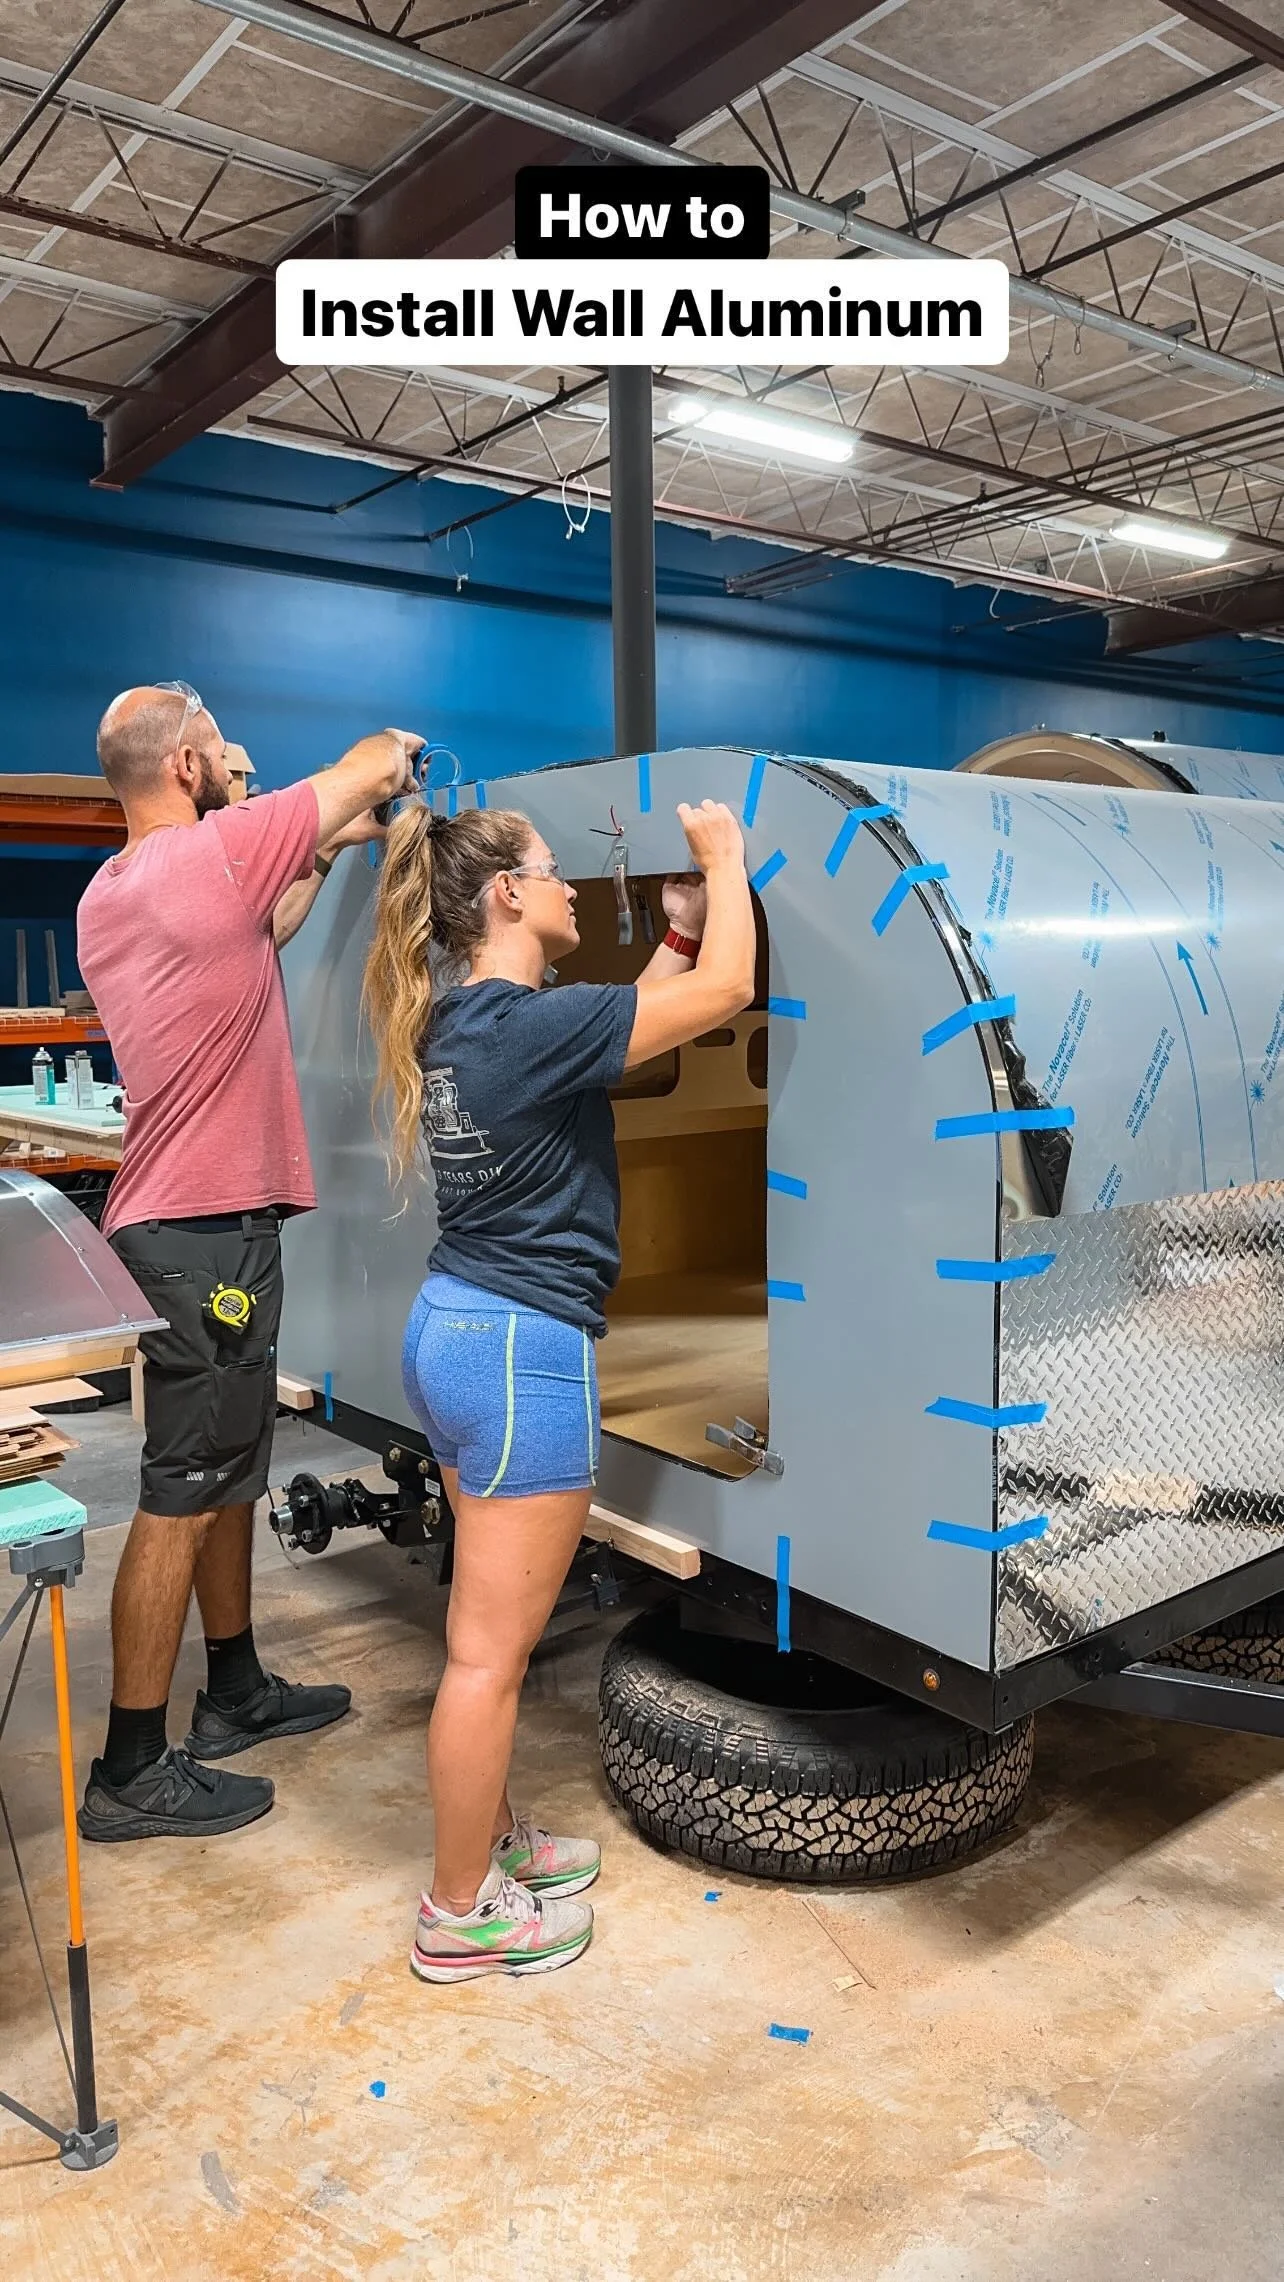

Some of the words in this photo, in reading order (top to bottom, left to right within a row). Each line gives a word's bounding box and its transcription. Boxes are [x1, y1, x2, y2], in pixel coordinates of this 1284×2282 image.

[1042, 1074, 1053, 1092] The
[1068, 989, 1084, 1024] Solution
[1050, 1088, 1058, 1102] for
[1055, 1062, 1070, 1089] LASER
[1066, 1040, 1076, 1063] Fiber
[1075, 1011, 1087, 1037] LASER
[1152, 1038, 1164, 1063] LASER
[1166, 1035, 1175, 1051] The
[1131, 1101, 1150, 1138] Solution
[1132, 1088, 1146, 1115] LASER
[1097, 1163, 1117, 1203] Solution
